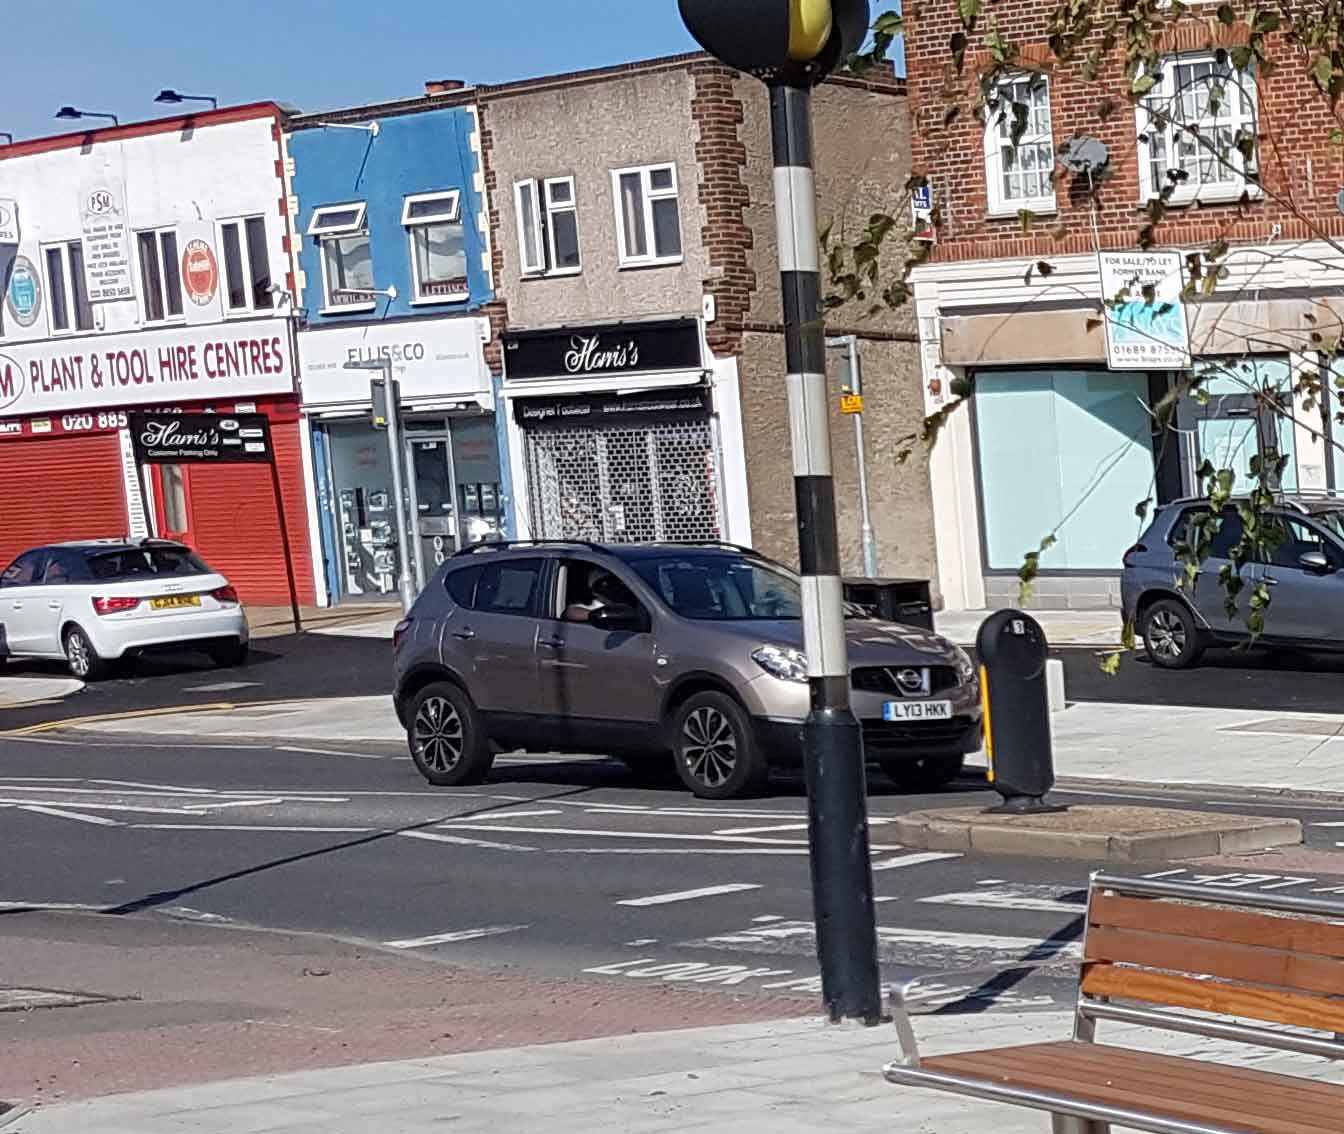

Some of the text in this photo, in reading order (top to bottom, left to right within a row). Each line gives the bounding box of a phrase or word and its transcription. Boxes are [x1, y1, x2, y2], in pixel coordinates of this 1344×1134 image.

[1105, 257, 1120, 265] FOR
[1113, 268, 1166, 276] FORMER BANK
[564, 333, 639, 373] Harris's
[1114, 345, 1146, 354] 01689
[30, 355, 83, 393] PLANT
[91, 353, 103, 388] &
[106, 349, 154, 386] TOOL
[159, 344, 198, 381] HIRE
[203, 337, 283, 379] CENTRES
[62, 414, 92, 431] 020
[98, 410, 136, 428] 885
[141, 421, 219, 447] Harris's
[894, 703, 947, 718] LY13 HKK
[582, 958, 793, 986] LOOK
